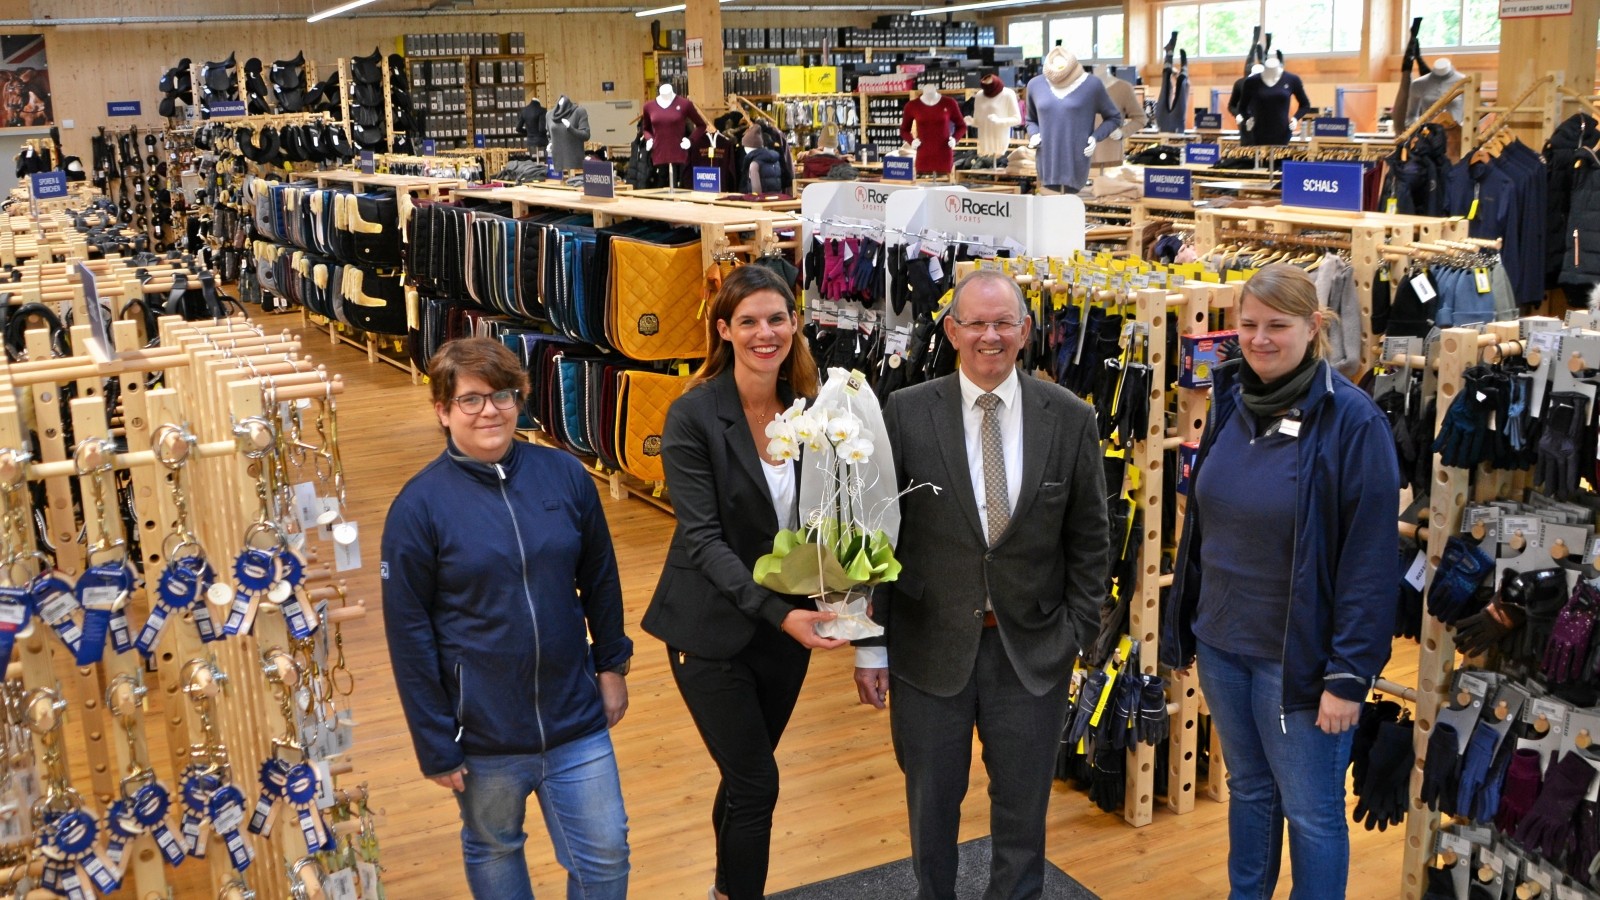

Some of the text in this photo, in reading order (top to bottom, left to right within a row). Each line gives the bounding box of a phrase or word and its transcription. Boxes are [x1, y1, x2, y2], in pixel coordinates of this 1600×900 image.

[1545, 3, 1569, 11] HALTEN!
[886, 160, 910, 169] DAMENMODE
[585, 173, 611, 185] SCHABRACKEN
[696, 172, 717, 181] DAMENMODE
[1149, 174, 1185, 185] DAMENMODE
[39, 177, 55, 186] SPOREN
[1303, 178, 1339, 193] SCHALS
[867, 188, 889, 203] Roe
[862, 203, 883, 212] SPORTS
[962, 198, 1010, 217] Roeckl
[955, 215, 982, 224] SPORTS
